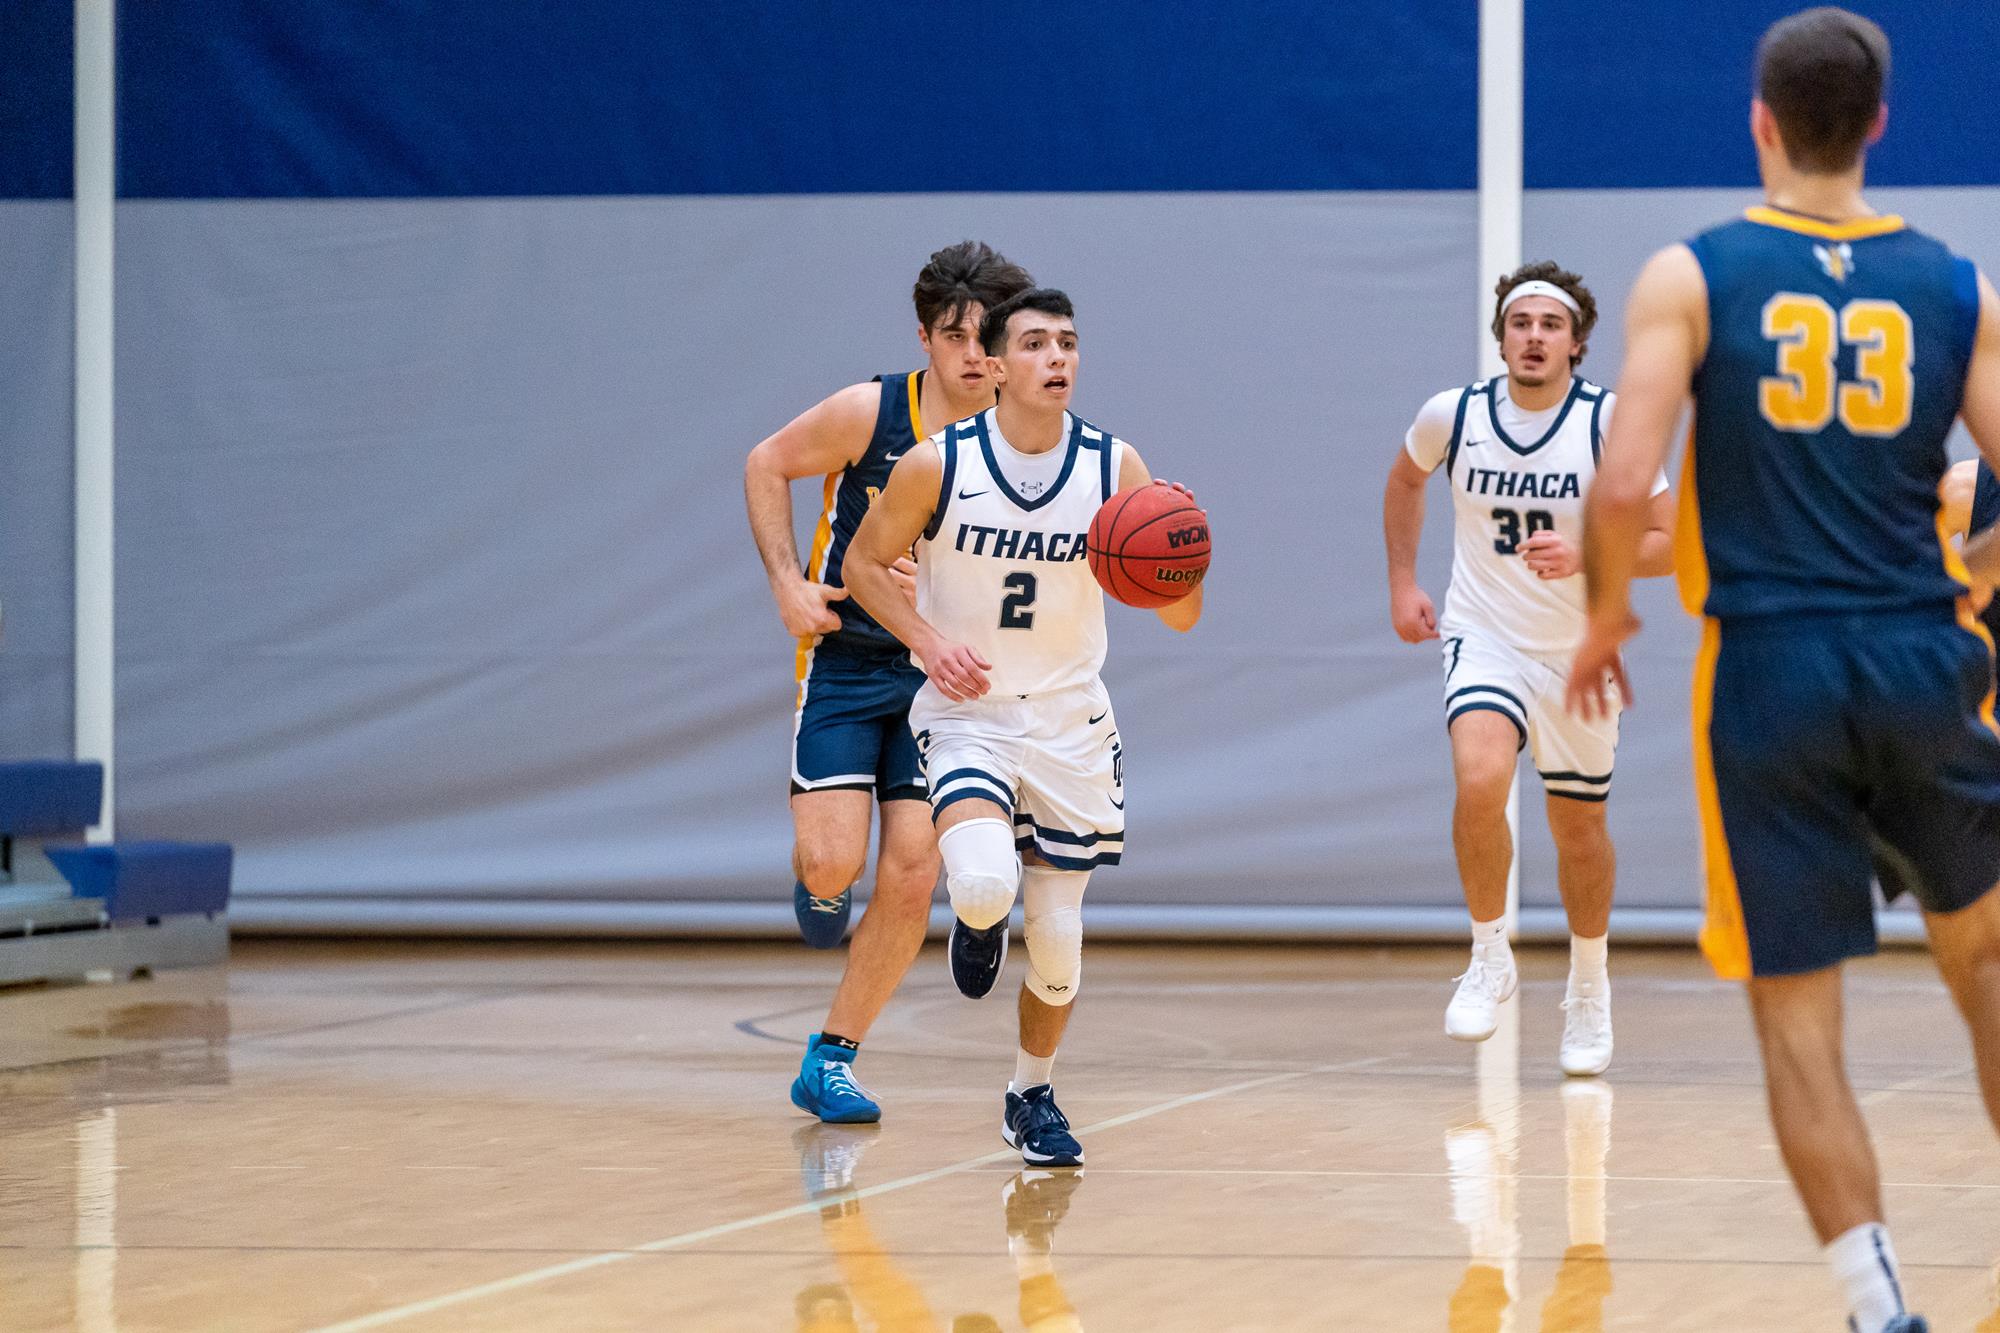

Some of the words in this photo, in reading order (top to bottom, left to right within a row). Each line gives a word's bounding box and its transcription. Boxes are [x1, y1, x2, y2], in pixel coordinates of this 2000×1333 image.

[1759, 291, 1915, 438] 33
[1466, 467, 1581, 498] ITHACA
[955, 523, 1088, 562] ITHACA
[1167, 525, 1209, 549] NCAA
[998, 571, 1039, 631] 2
